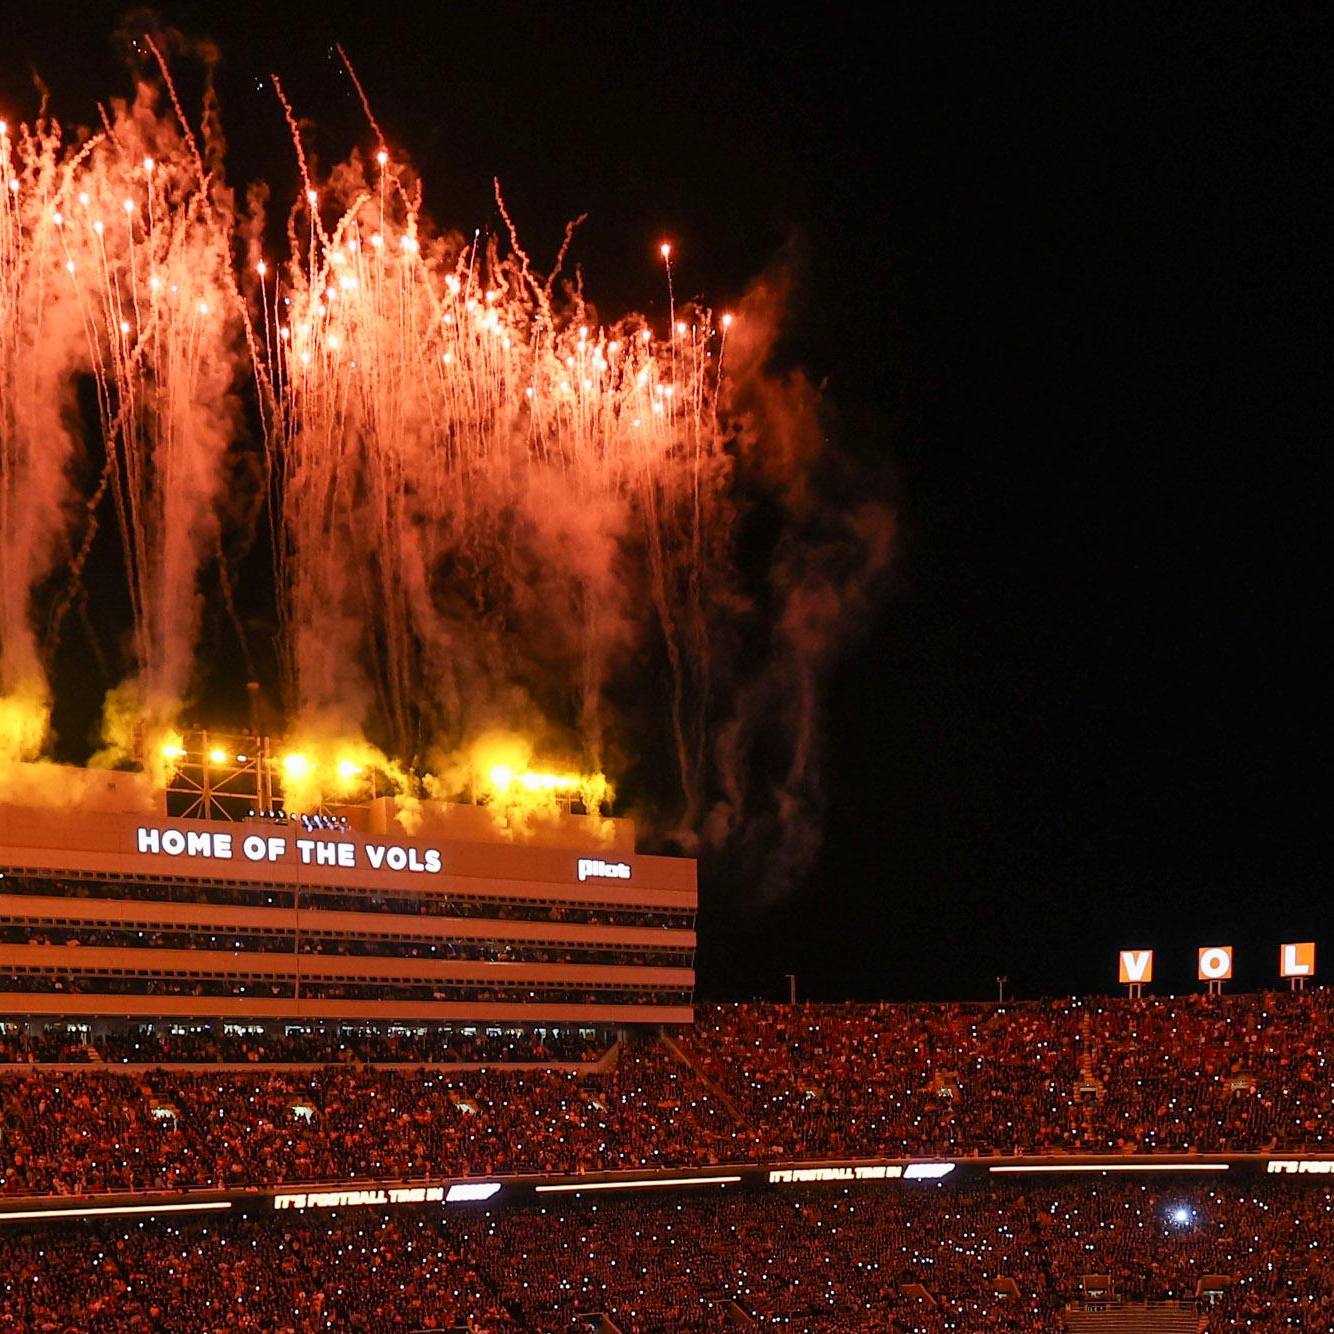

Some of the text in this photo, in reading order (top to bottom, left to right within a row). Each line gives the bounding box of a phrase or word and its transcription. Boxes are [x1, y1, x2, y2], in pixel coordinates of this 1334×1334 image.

[138, 828, 442, 873] HOME OF THE VOLS
[793, 1168, 854, 1181] FOOTBALL
[274, 1187, 444, 1210] IT'S FOOTBALL TIME IN
